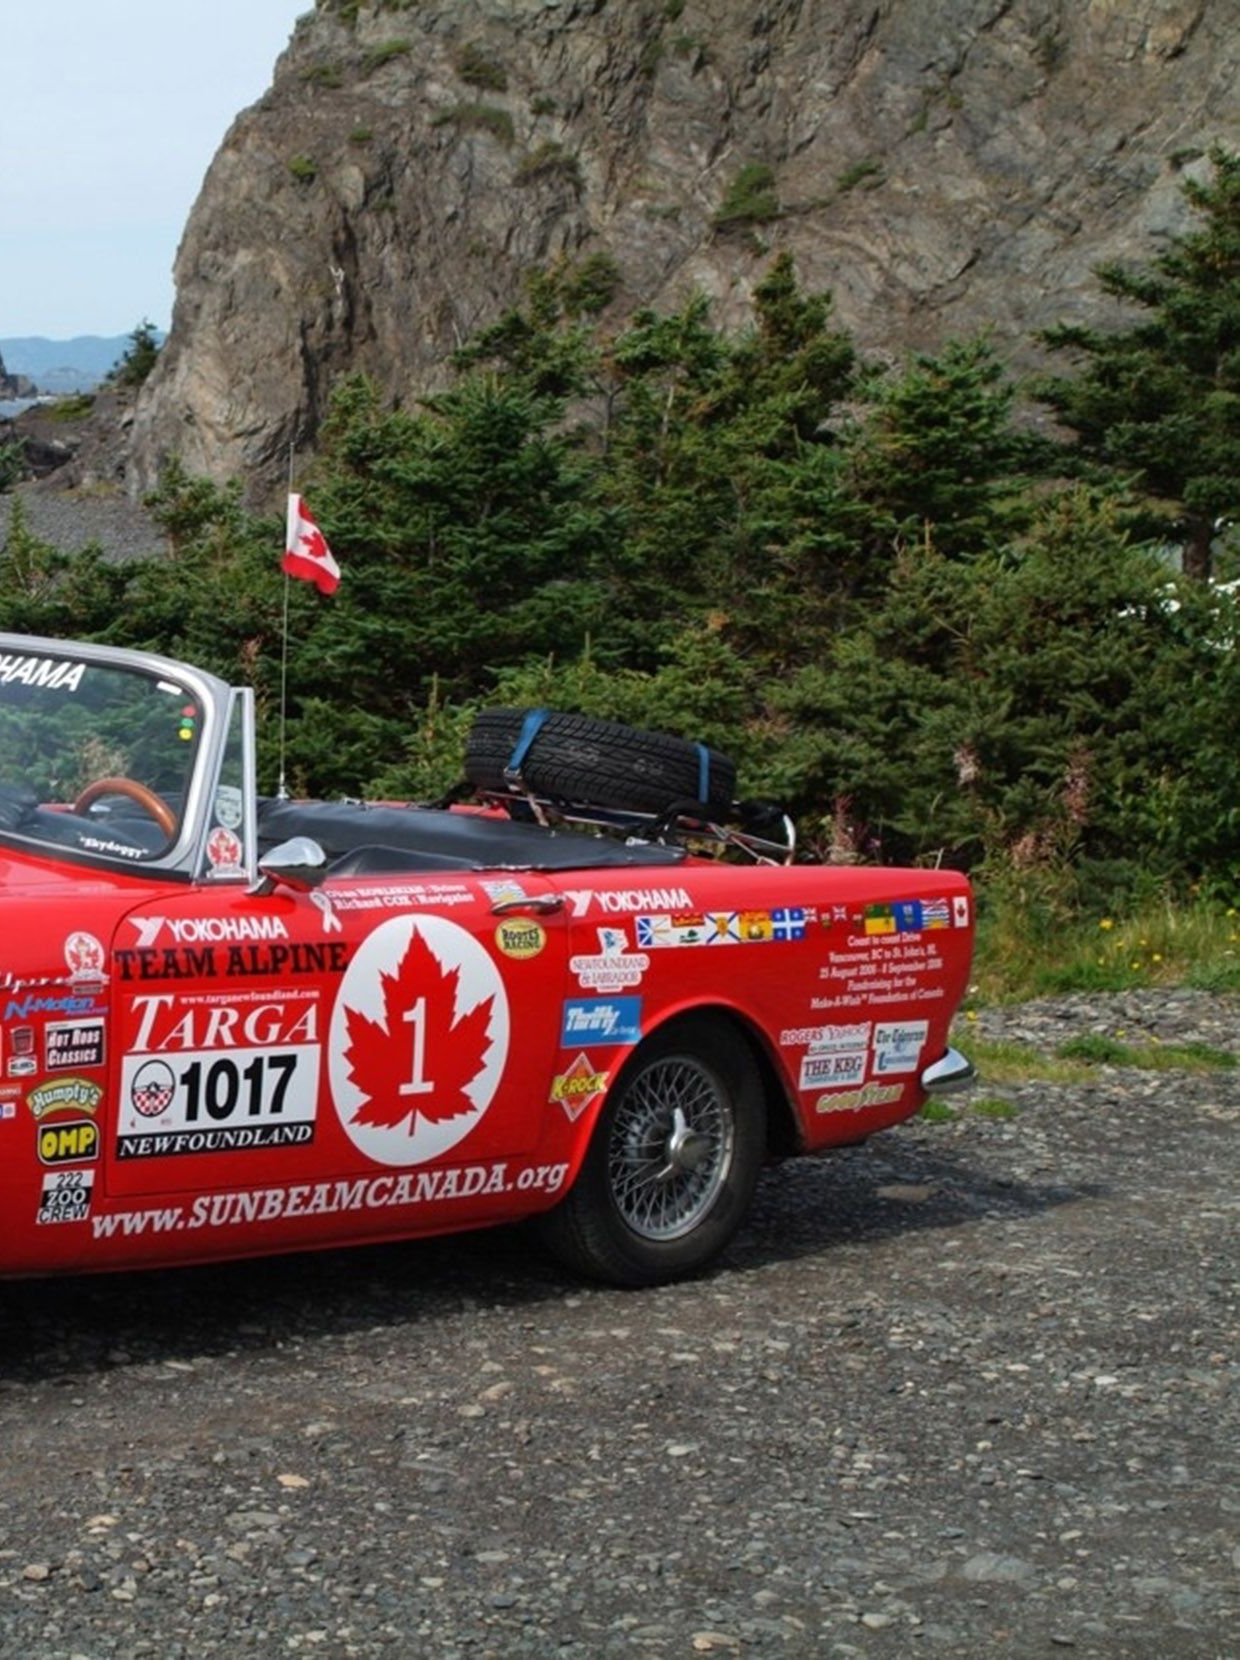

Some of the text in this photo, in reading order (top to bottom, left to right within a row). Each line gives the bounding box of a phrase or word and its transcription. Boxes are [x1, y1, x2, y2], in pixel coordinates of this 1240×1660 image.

[595, 888, 693, 912] YOKOHAMA
[166, 916, 289, 942] YOKOHAMA
[502, 927, 540, 941] ROOTES
[504, 938, 540, 950] RACING
[114, 941, 348, 981] TEAM ALPINE
[126, 995, 321, 1053] TARGA
[565, 1004, 621, 1036] Thrifty
[48, 1047, 98, 1067] CLASSICS
[398, 996, 435, 1096] 1
[804, 1058, 831, 1077] THE
[833, 1055, 863, 1075] KEG
[33, 1083, 99, 1116] Humpty's
[179, 1053, 298, 1122] 1017
[41, 1126, 95, 1159] OMP
[119, 1124, 313, 1157] NEWFOUNDLAND
[56, 1172, 84, 1189] 222
[45, 1188, 87, 1208] ZOO
[91, 1162, 569, 1239] www.SUNBEAMCANADA.org
[39, 1204, 90, 1224] CREW
